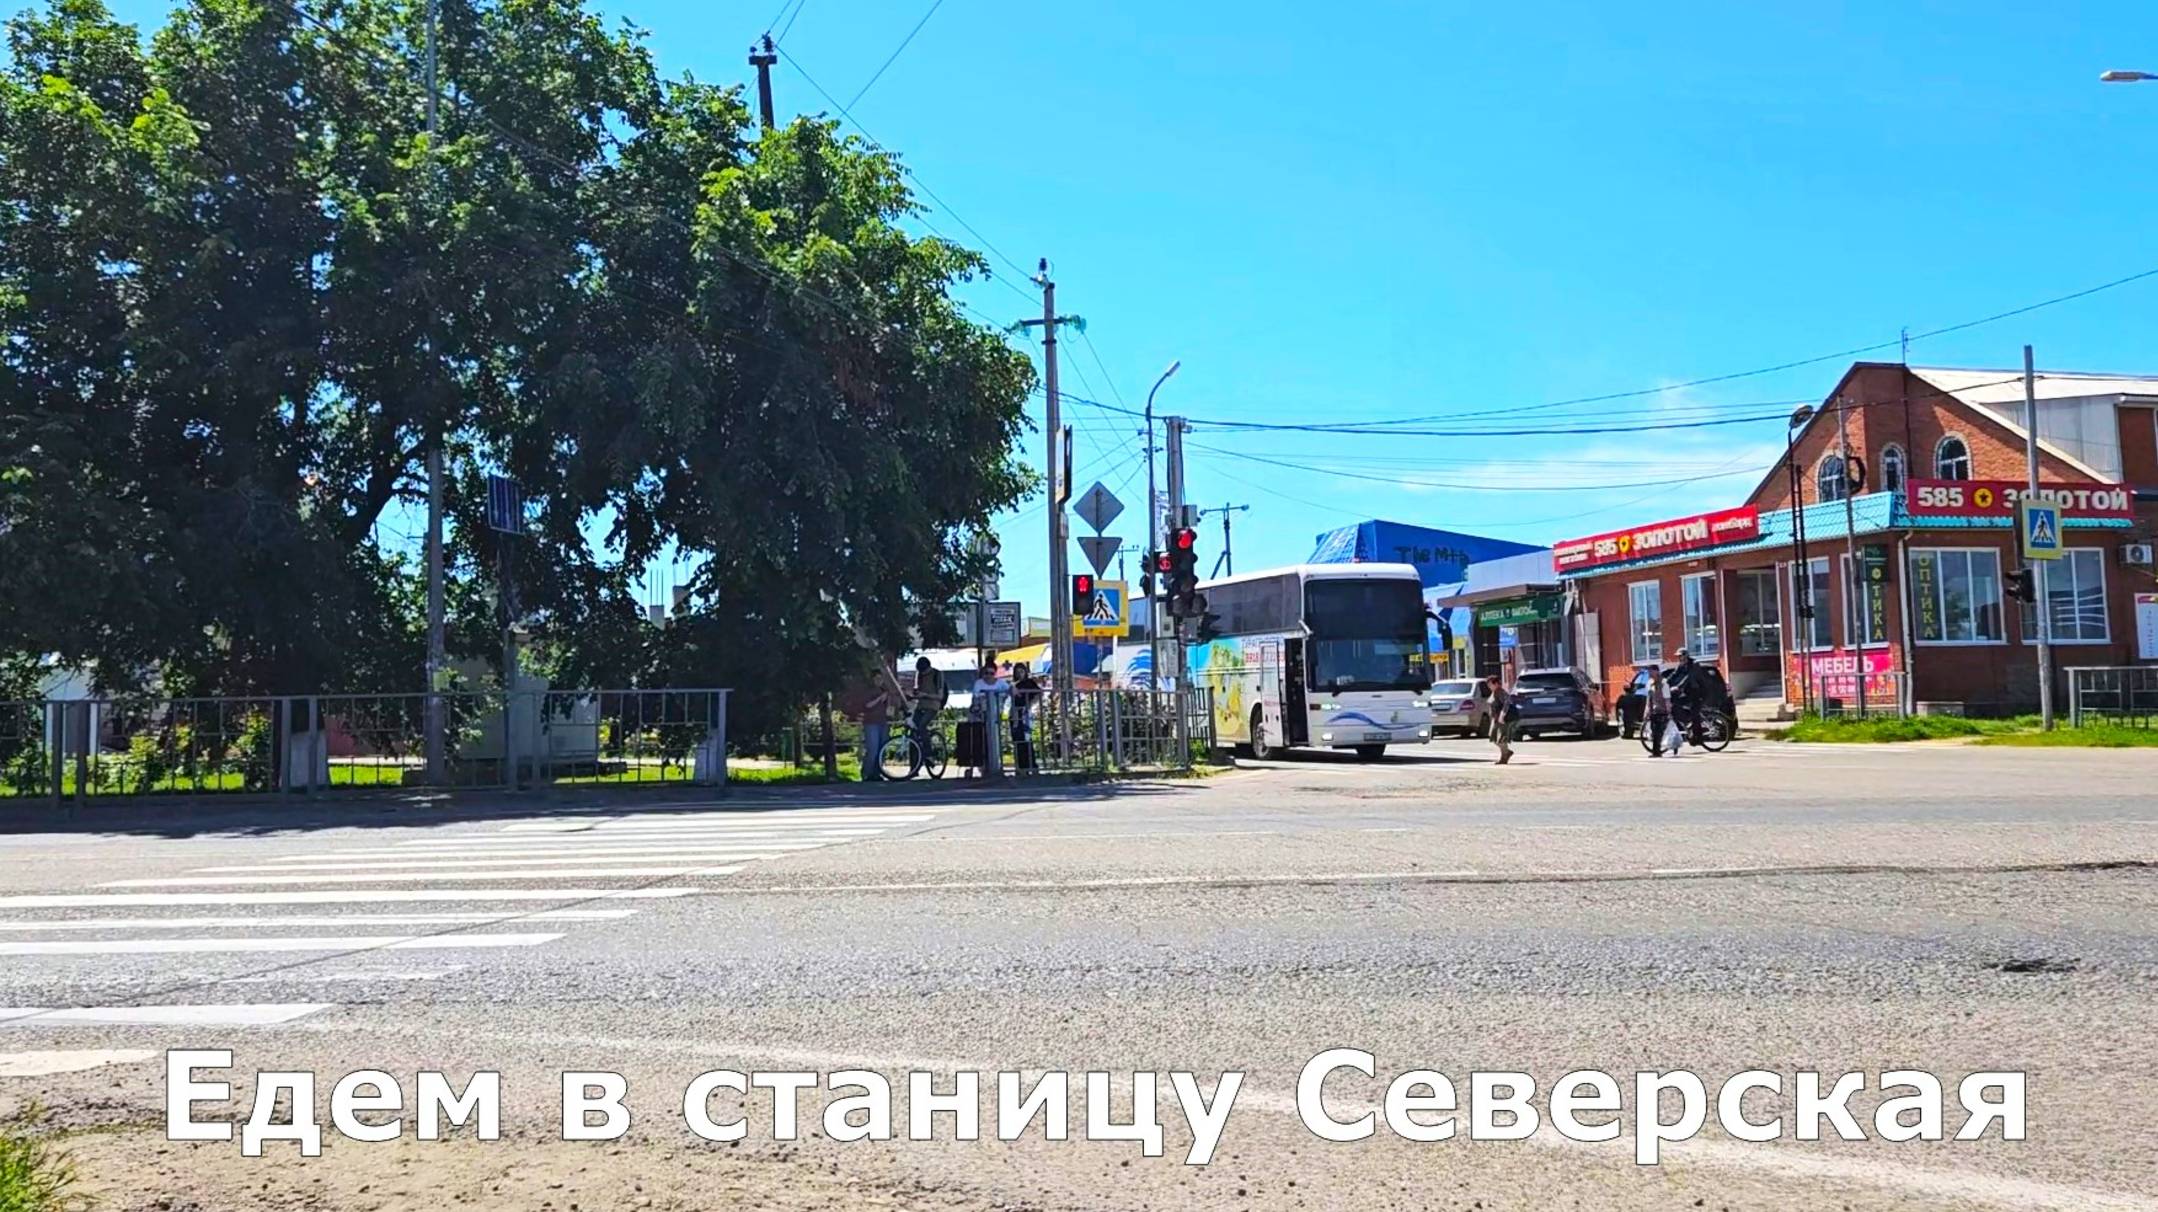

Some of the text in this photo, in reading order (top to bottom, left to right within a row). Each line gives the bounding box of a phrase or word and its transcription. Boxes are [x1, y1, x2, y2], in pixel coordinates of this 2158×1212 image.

[1916, 486, 1965, 507] 585
[1594, 539, 1618, 558] 585
[1632, 519, 1709, 552] ЗОЛОТОЙ
[1919, 554, 1934, 638] ОПТИКА
